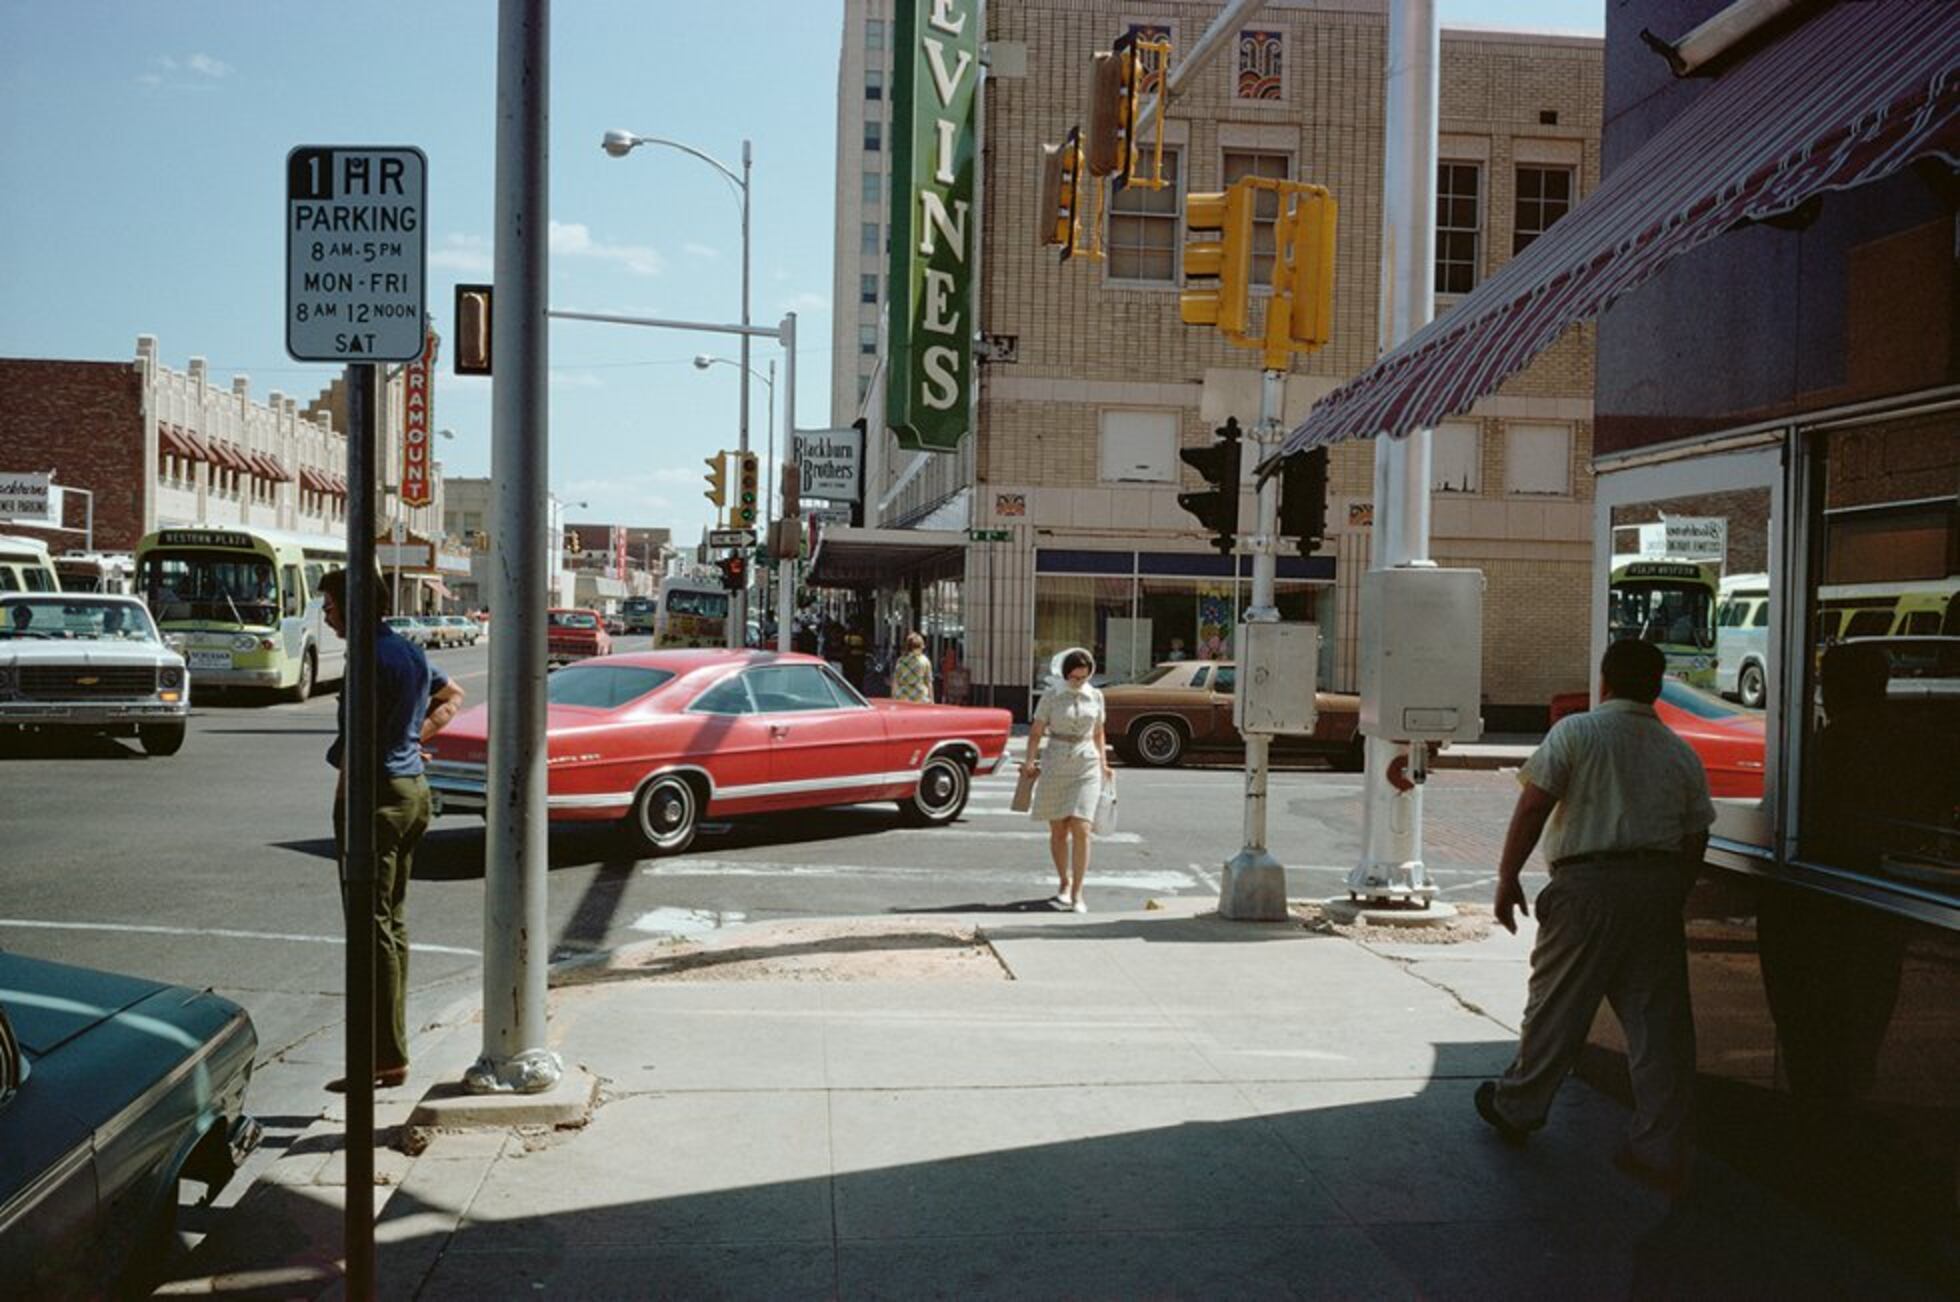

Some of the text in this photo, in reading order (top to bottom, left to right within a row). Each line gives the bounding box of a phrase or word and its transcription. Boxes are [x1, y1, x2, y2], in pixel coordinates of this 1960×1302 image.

[308, 156, 405, 195] 1 HR
[295, 206, 417, 232] PARKING
[335, 333, 377, 353] SAT
[793, 435, 853, 467] Blackburn
[803, 460, 853, 492] Brothers
